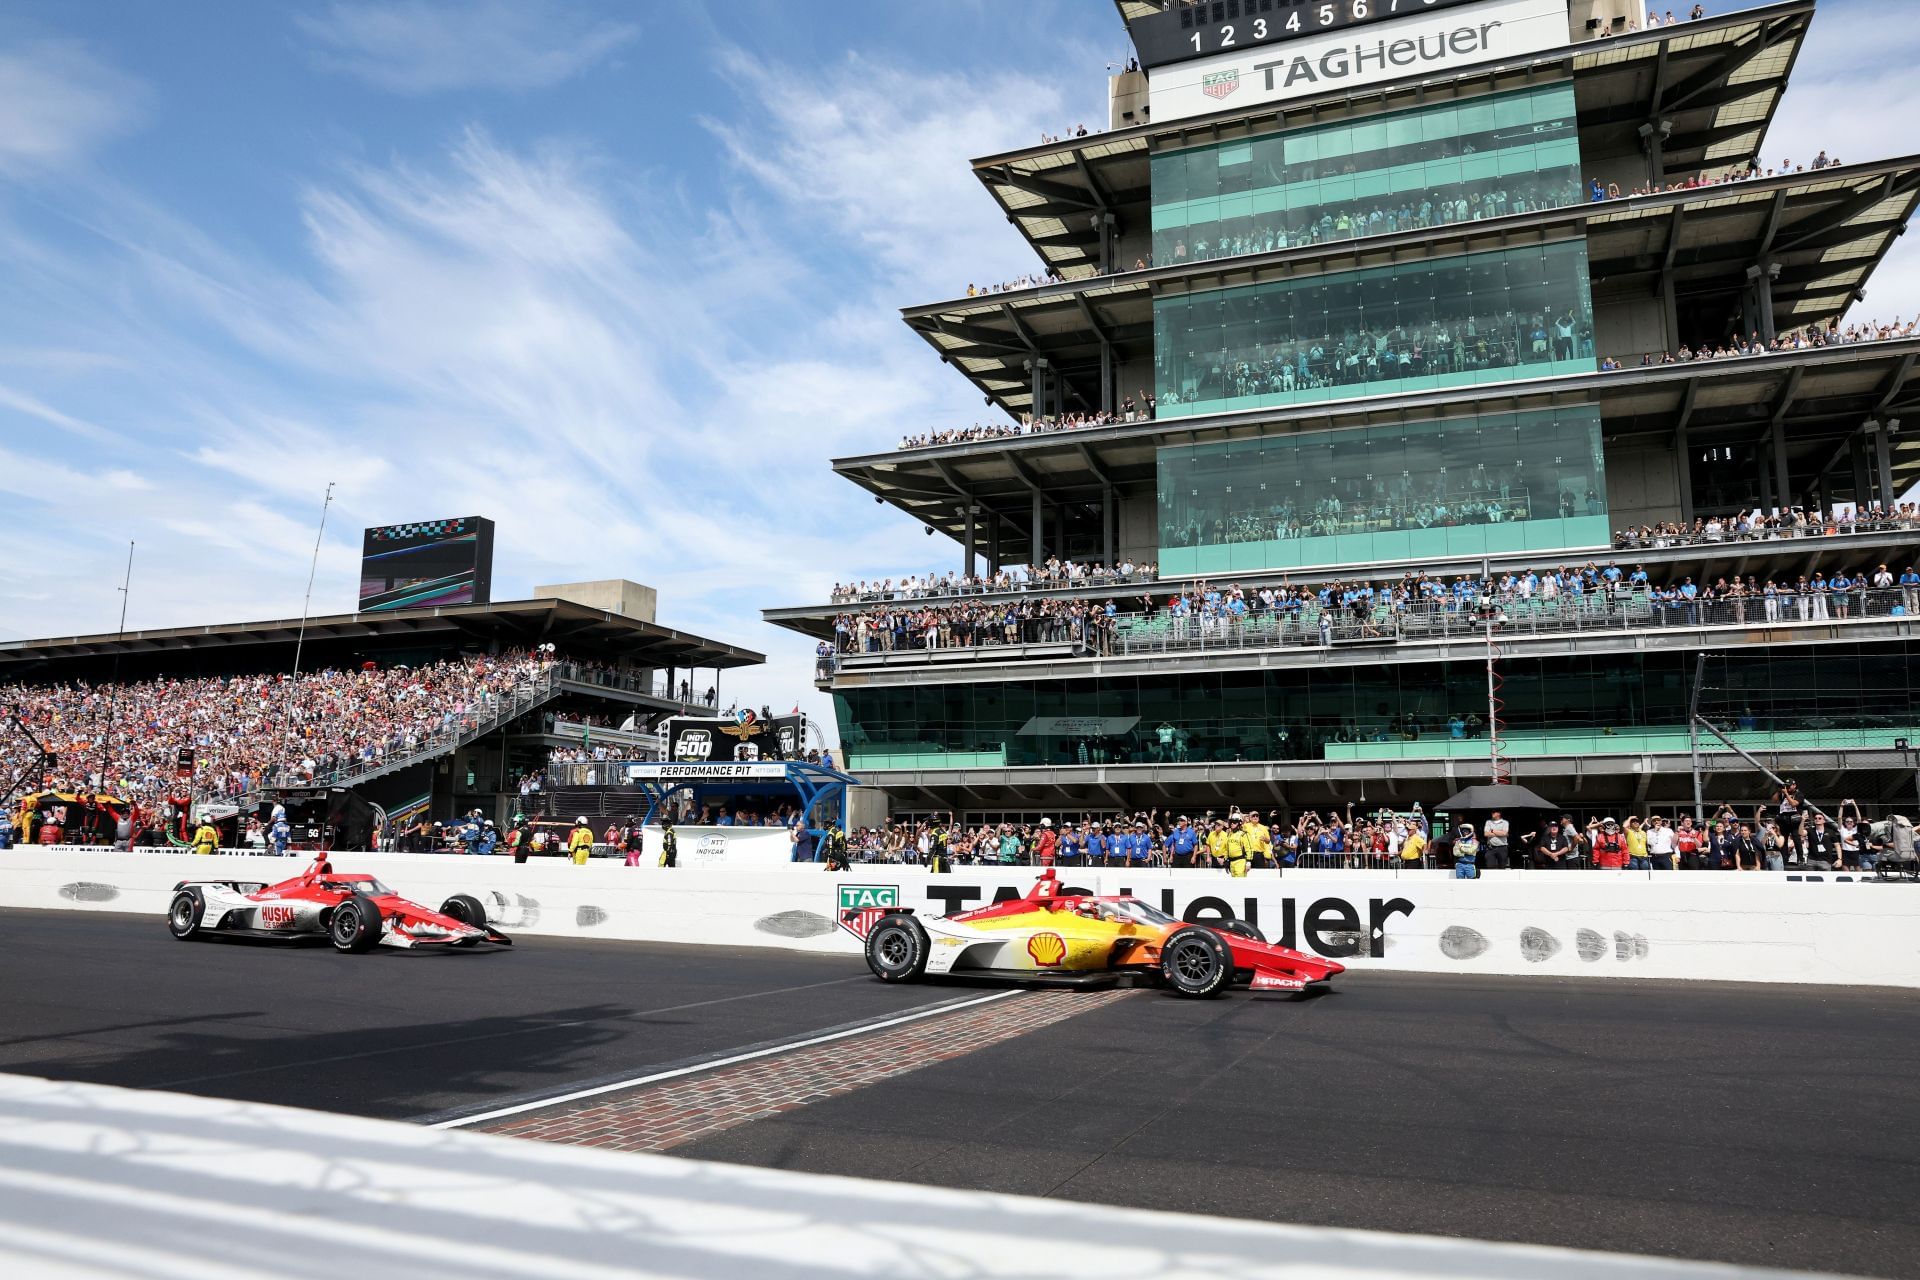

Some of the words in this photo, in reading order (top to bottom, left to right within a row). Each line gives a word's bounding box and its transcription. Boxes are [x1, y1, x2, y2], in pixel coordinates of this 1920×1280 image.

[1190, 31, 1201, 51] 1
[1220, 25, 1235, 47] 2
[1253, 18, 1268, 39] 3
[1285, 11, 1301, 32] 4
[1319, 4, 1334, 26] 5
[1352, 0, 1368, 19] 6
[1206, 73, 1236, 85] TAG
[1206, 80, 1237, 97] HEUER
[686, 734, 706, 742] INDY
[676, 741, 710, 756] 500
[660, 766, 733, 776] PERFORMANCE
[735, 766, 751, 776] PIT
[308, 828, 319, 838] 5G
[1038, 880, 1052, 897] 2
[843, 889, 893, 907] TAG
[261, 906, 295, 921] HUSKI
[1256, 976, 1305, 987] HITACHI
